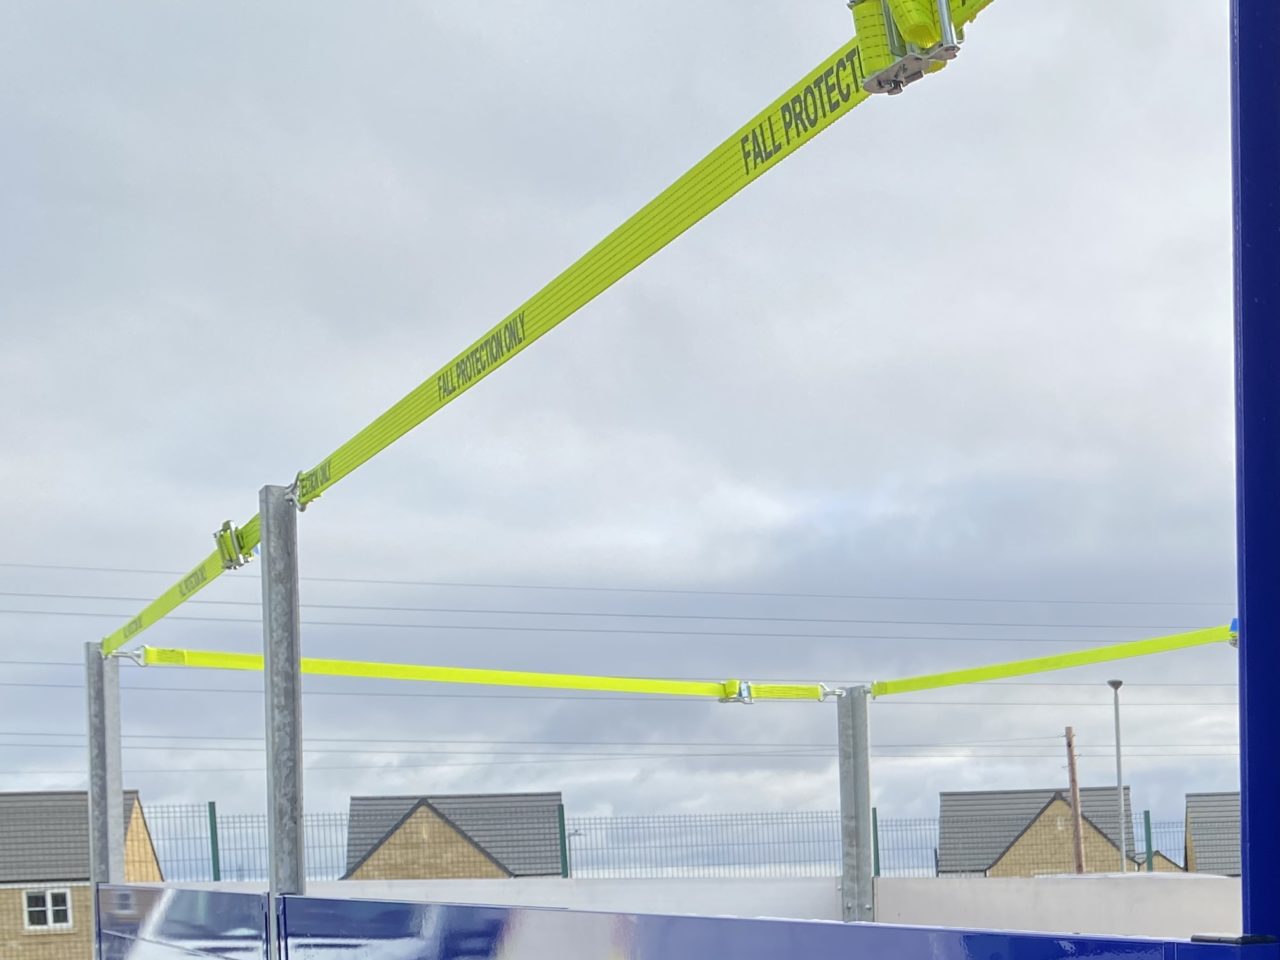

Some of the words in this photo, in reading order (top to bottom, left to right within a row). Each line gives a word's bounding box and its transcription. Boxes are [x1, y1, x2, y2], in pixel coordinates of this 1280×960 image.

[740, 116, 782, 176] FALL
[437, 367, 457, 402] FALL
[455, 328, 505, 390] PROTECTION
[503, 310, 526, 353] ONLY
